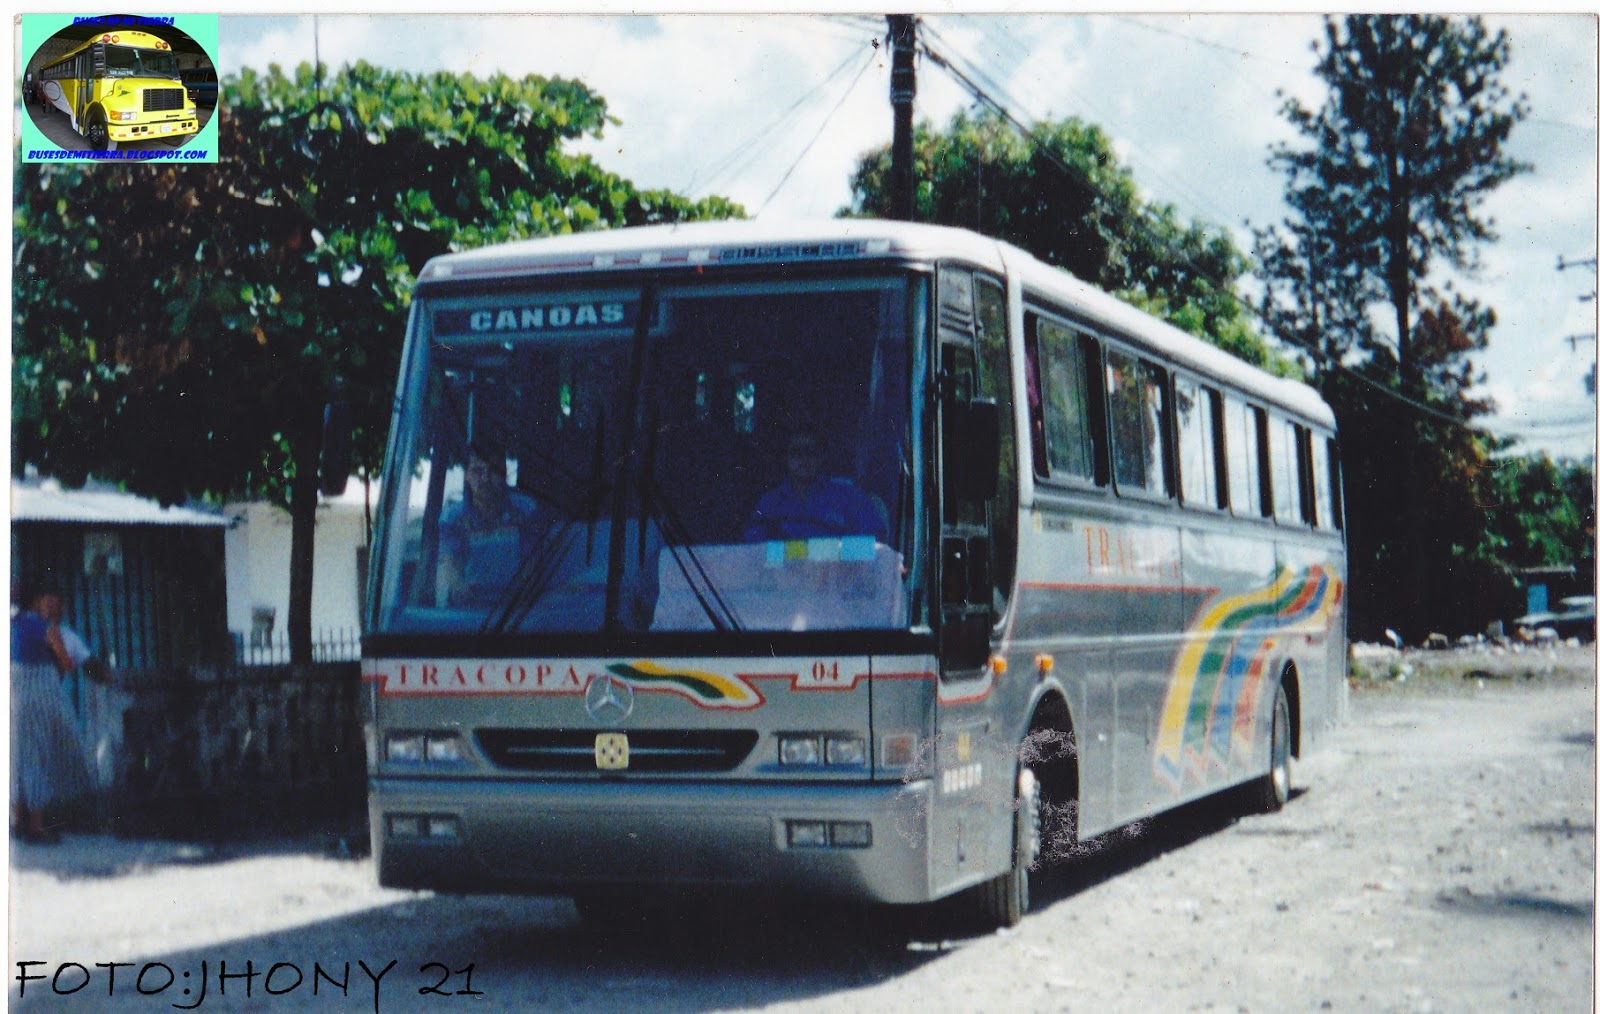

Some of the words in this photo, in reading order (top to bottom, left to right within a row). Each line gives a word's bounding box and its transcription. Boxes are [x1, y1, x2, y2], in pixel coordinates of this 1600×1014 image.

[470, 303, 624, 331] CANOAS
[395, 663, 581, 687] TRACOPA
[812, 661, 840, 683] 04
